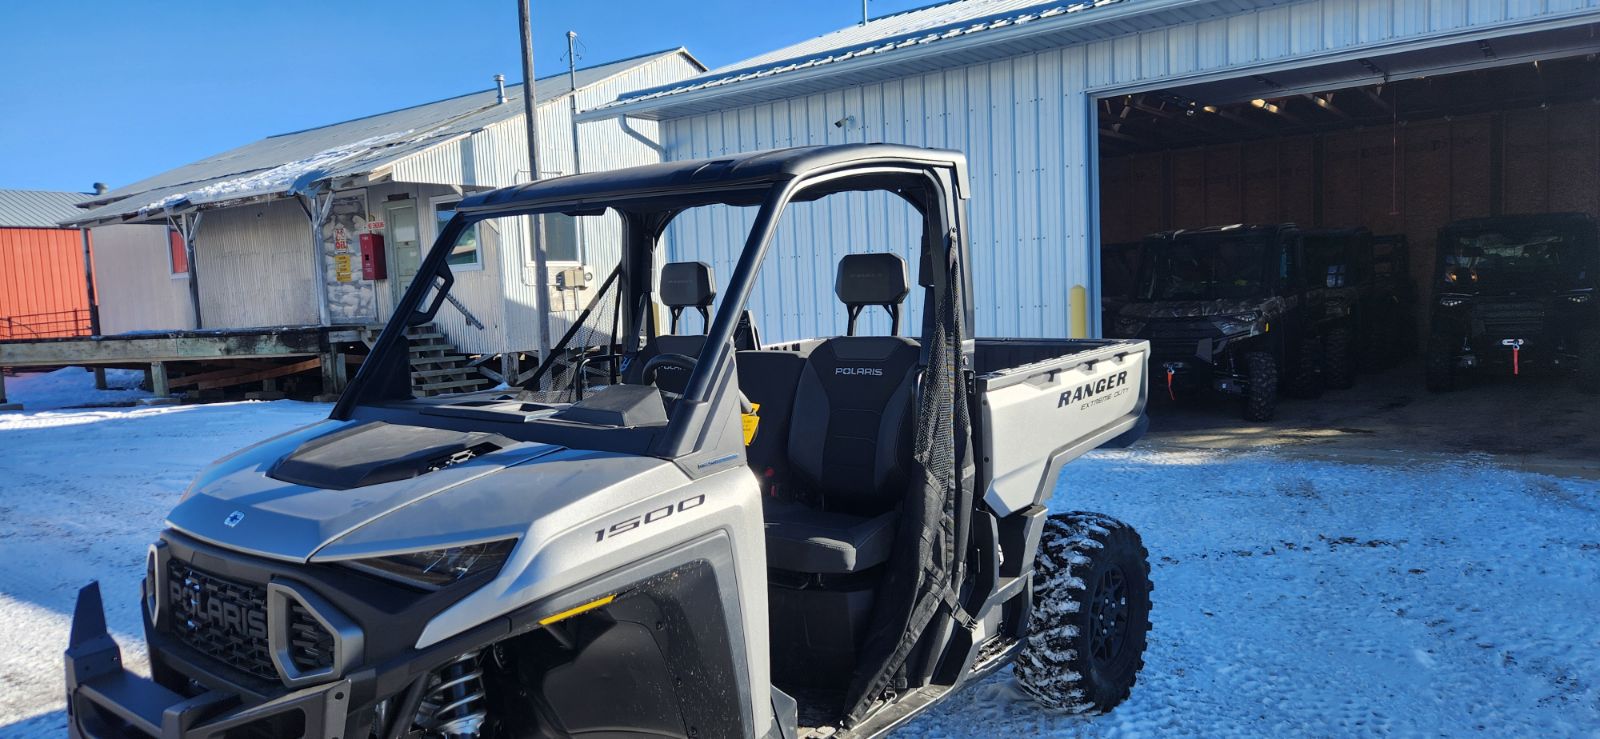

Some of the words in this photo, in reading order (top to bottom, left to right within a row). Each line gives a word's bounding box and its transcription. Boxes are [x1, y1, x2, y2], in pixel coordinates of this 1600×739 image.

[834, 366, 883, 376] POLARIS
[1057, 370, 1128, 409] RANGER
[1080, 393, 1112, 411] EXTREME
[594, 494, 706, 543] 1500
[169, 579, 268, 639] POLARIS
